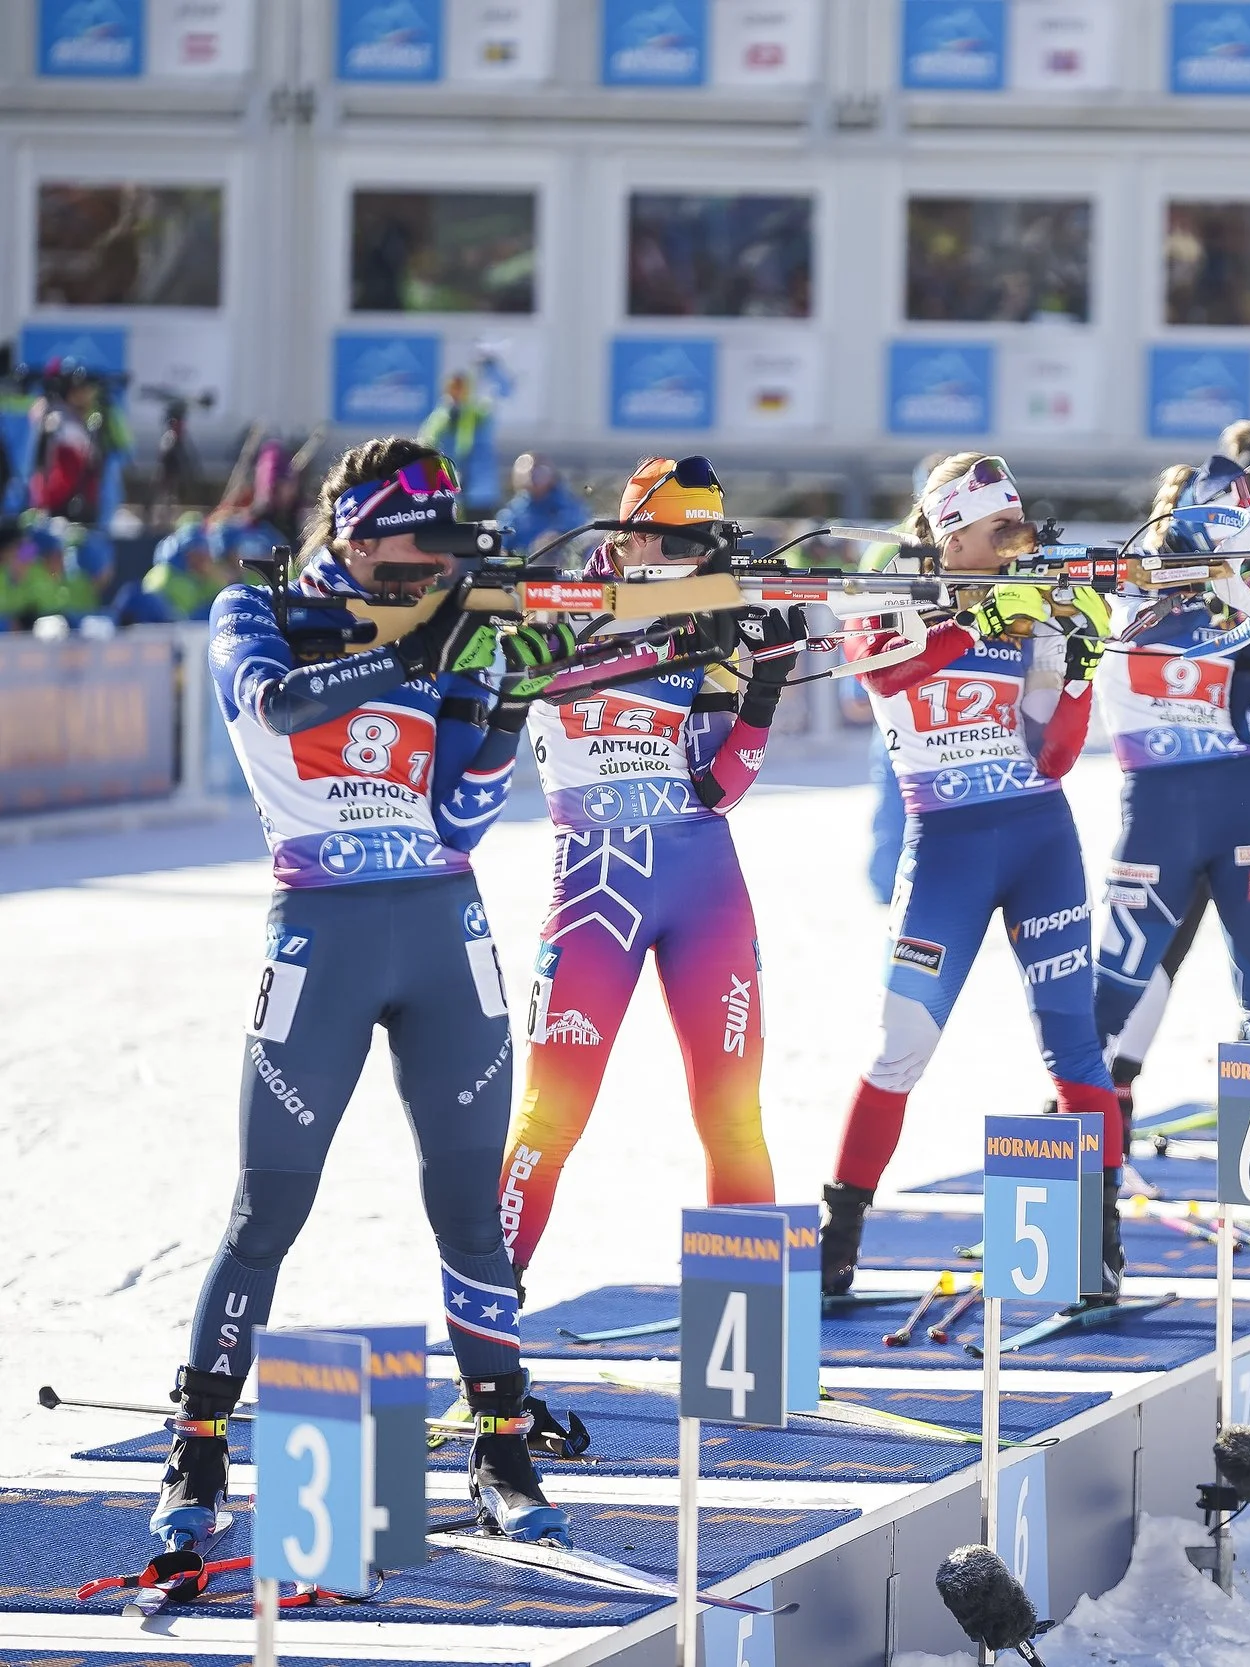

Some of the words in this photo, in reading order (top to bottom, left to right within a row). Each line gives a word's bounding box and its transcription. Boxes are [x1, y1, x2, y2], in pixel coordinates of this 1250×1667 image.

[327, 657, 395, 687] ARIENS
[1161, 656, 1202, 697] 9
[918, 679, 996, 727] 12
[342, 713, 400, 775] 8
[588, 740, 670, 756] ANTHOLZ
[637, 781, 698, 817] iX2
[381, 830, 447, 869] iX2
[254, 967, 275, 1031] 8
[250, 1041, 305, 1115] maloja
[474, 1032, 512, 1092] ARIEN
[1011, 1186, 1049, 1295] 5
[209, 1291, 248, 1376] USA
[706, 1291, 755, 1418] 4
[282, 1423, 333, 1579] 3
